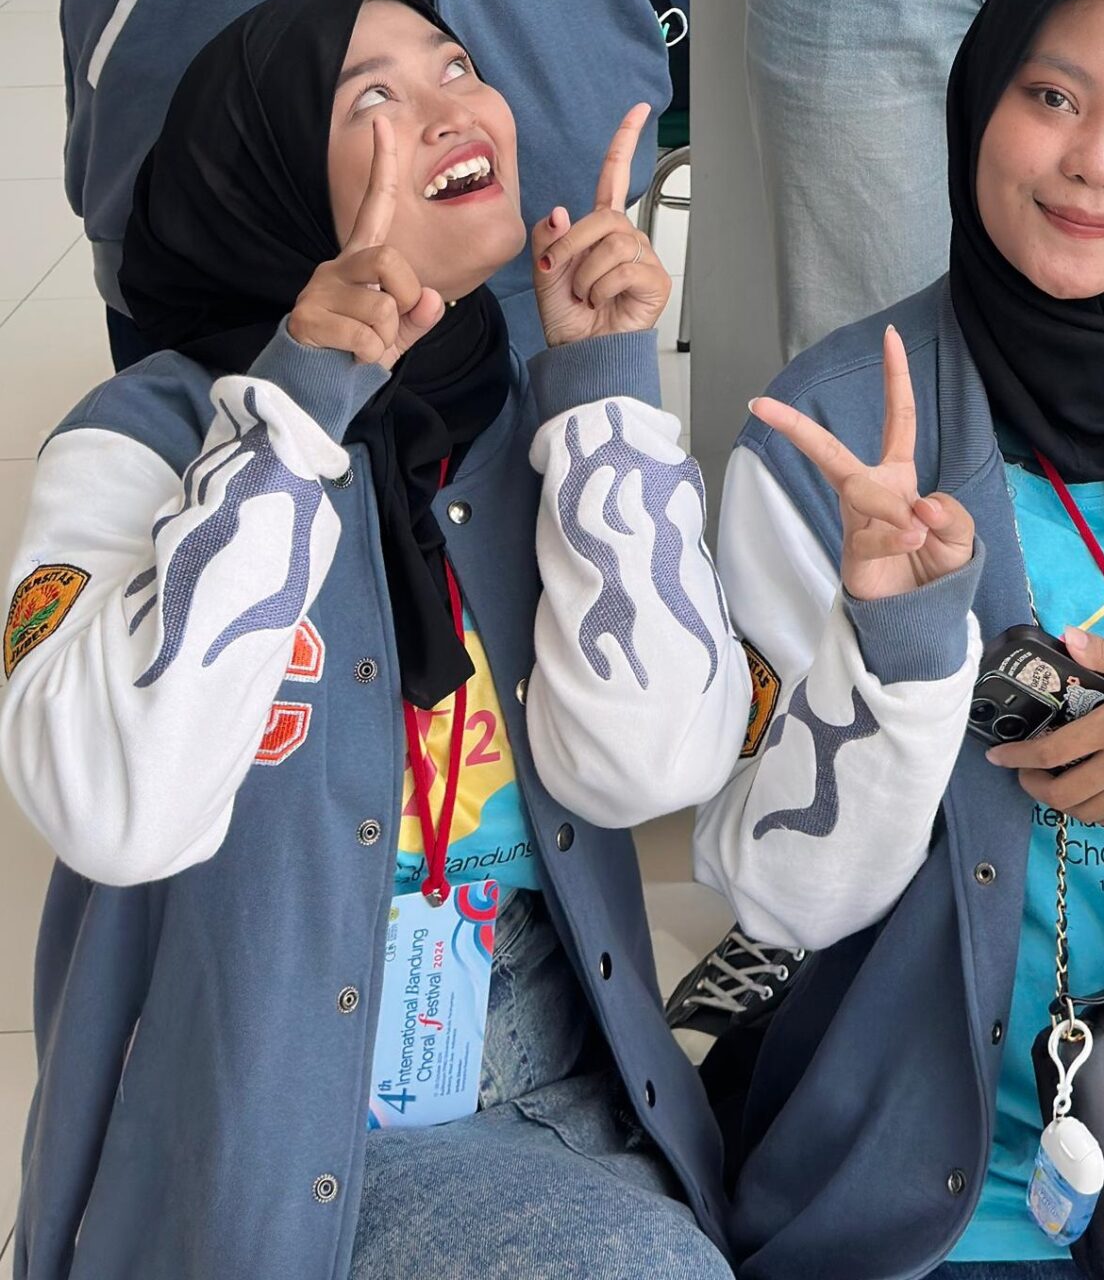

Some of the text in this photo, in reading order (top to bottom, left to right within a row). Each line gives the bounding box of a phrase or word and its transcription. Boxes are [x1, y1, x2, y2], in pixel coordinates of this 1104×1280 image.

[405, 928, 428, 995] Bandung
[396, 997, 419, 1087] International
[417, 1034, 435, 1083] Choral
[433, 940, 444, 968] 2024
